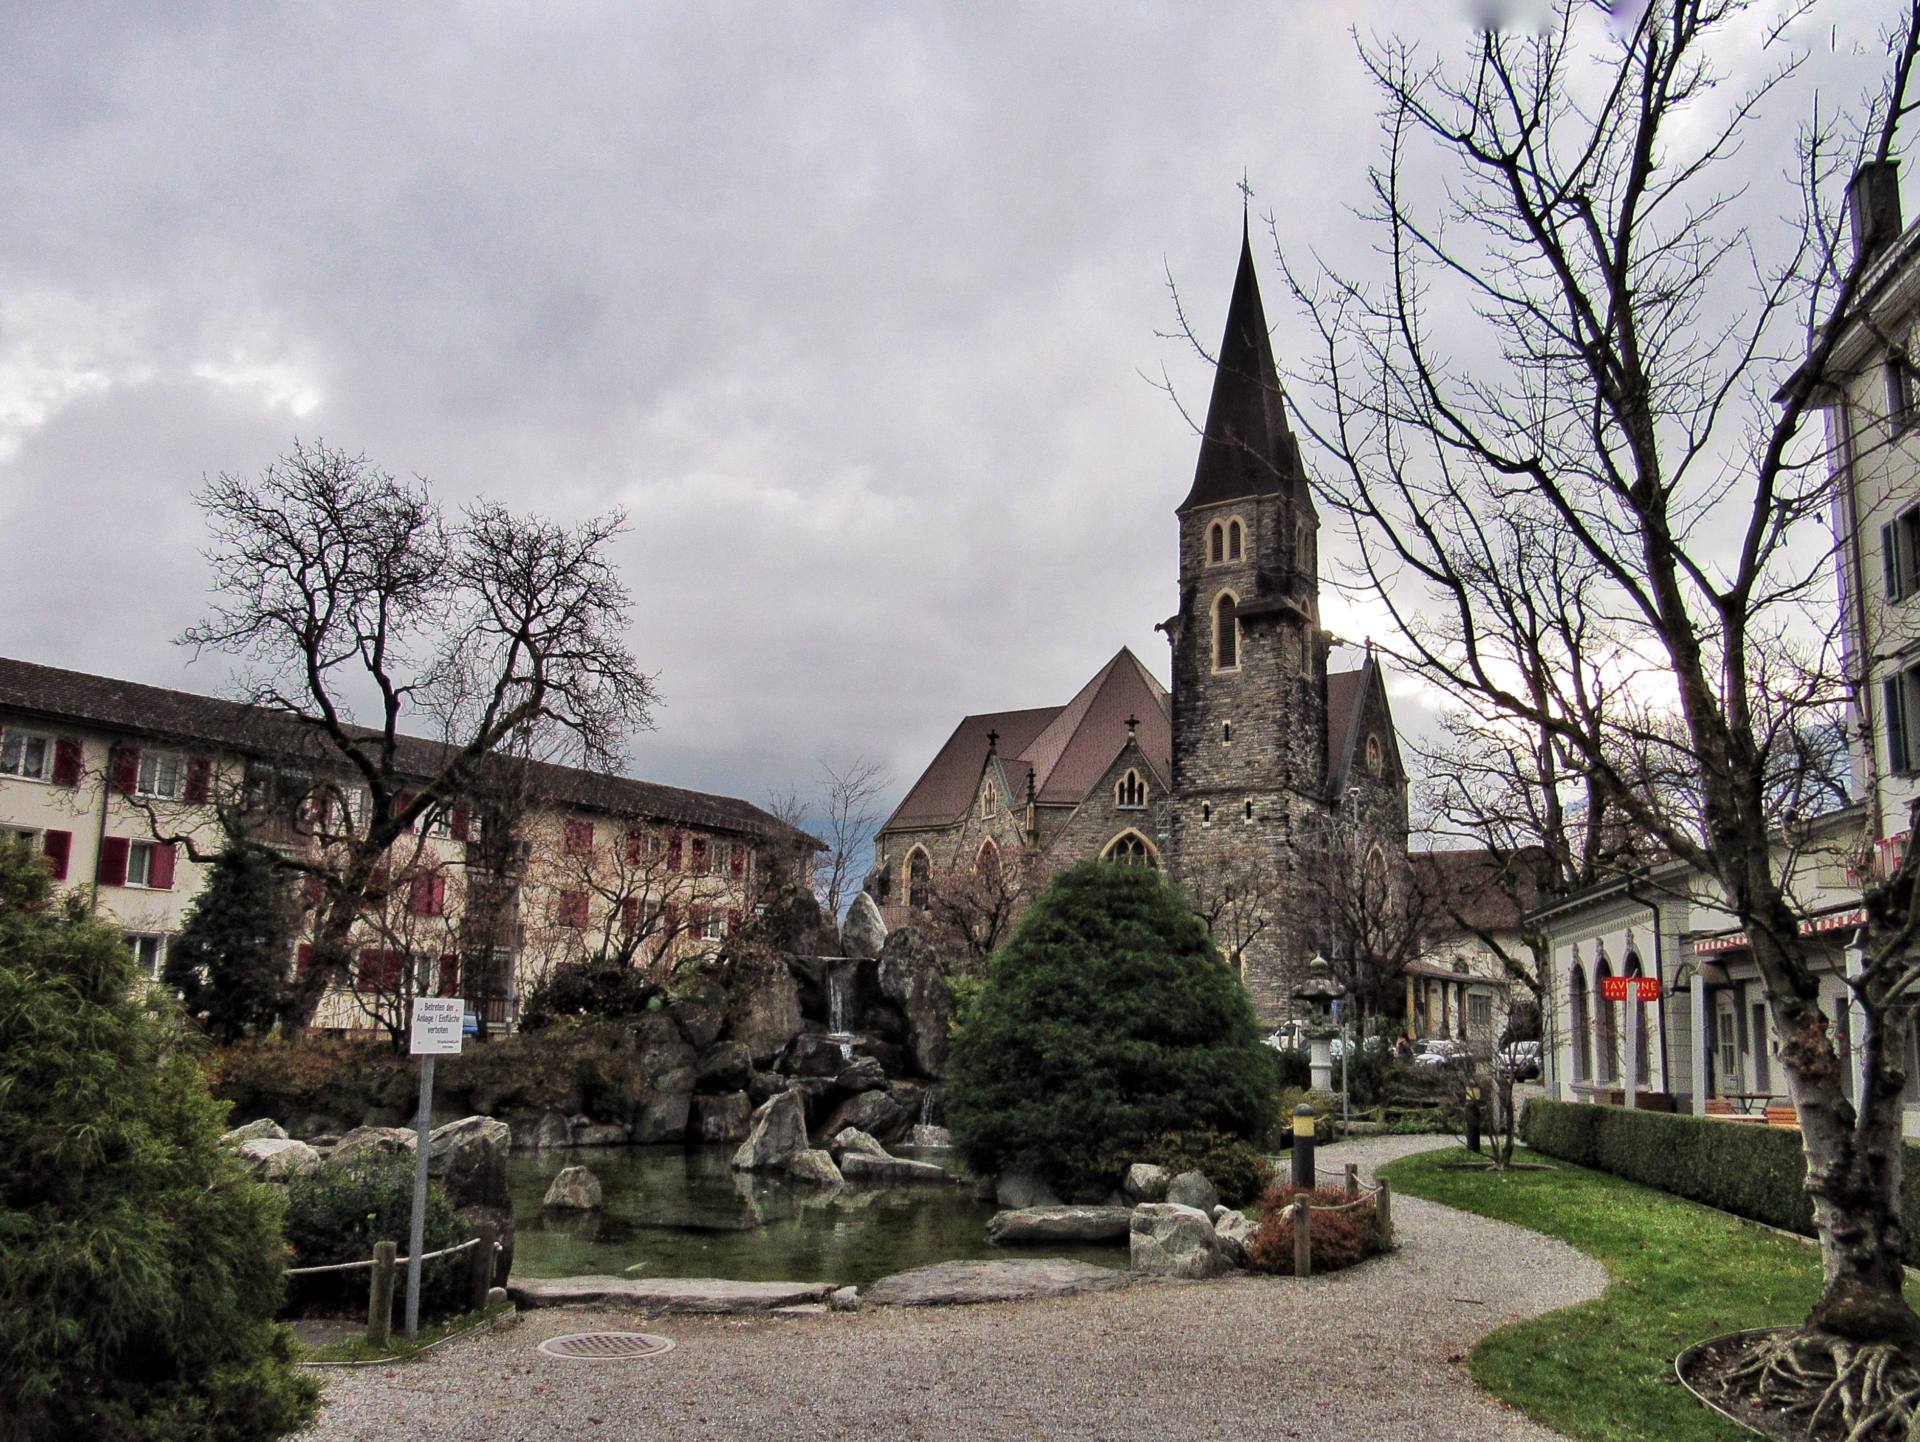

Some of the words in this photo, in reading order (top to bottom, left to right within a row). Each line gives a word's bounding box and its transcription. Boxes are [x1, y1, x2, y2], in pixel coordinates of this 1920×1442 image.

[1603, 980, 1657, 991] TAVRNE
[425, 1003, 445, 1011] Betreten
[446, 1003, 454, 1011] der
[417, 1014, 434, 1024] Anlage
